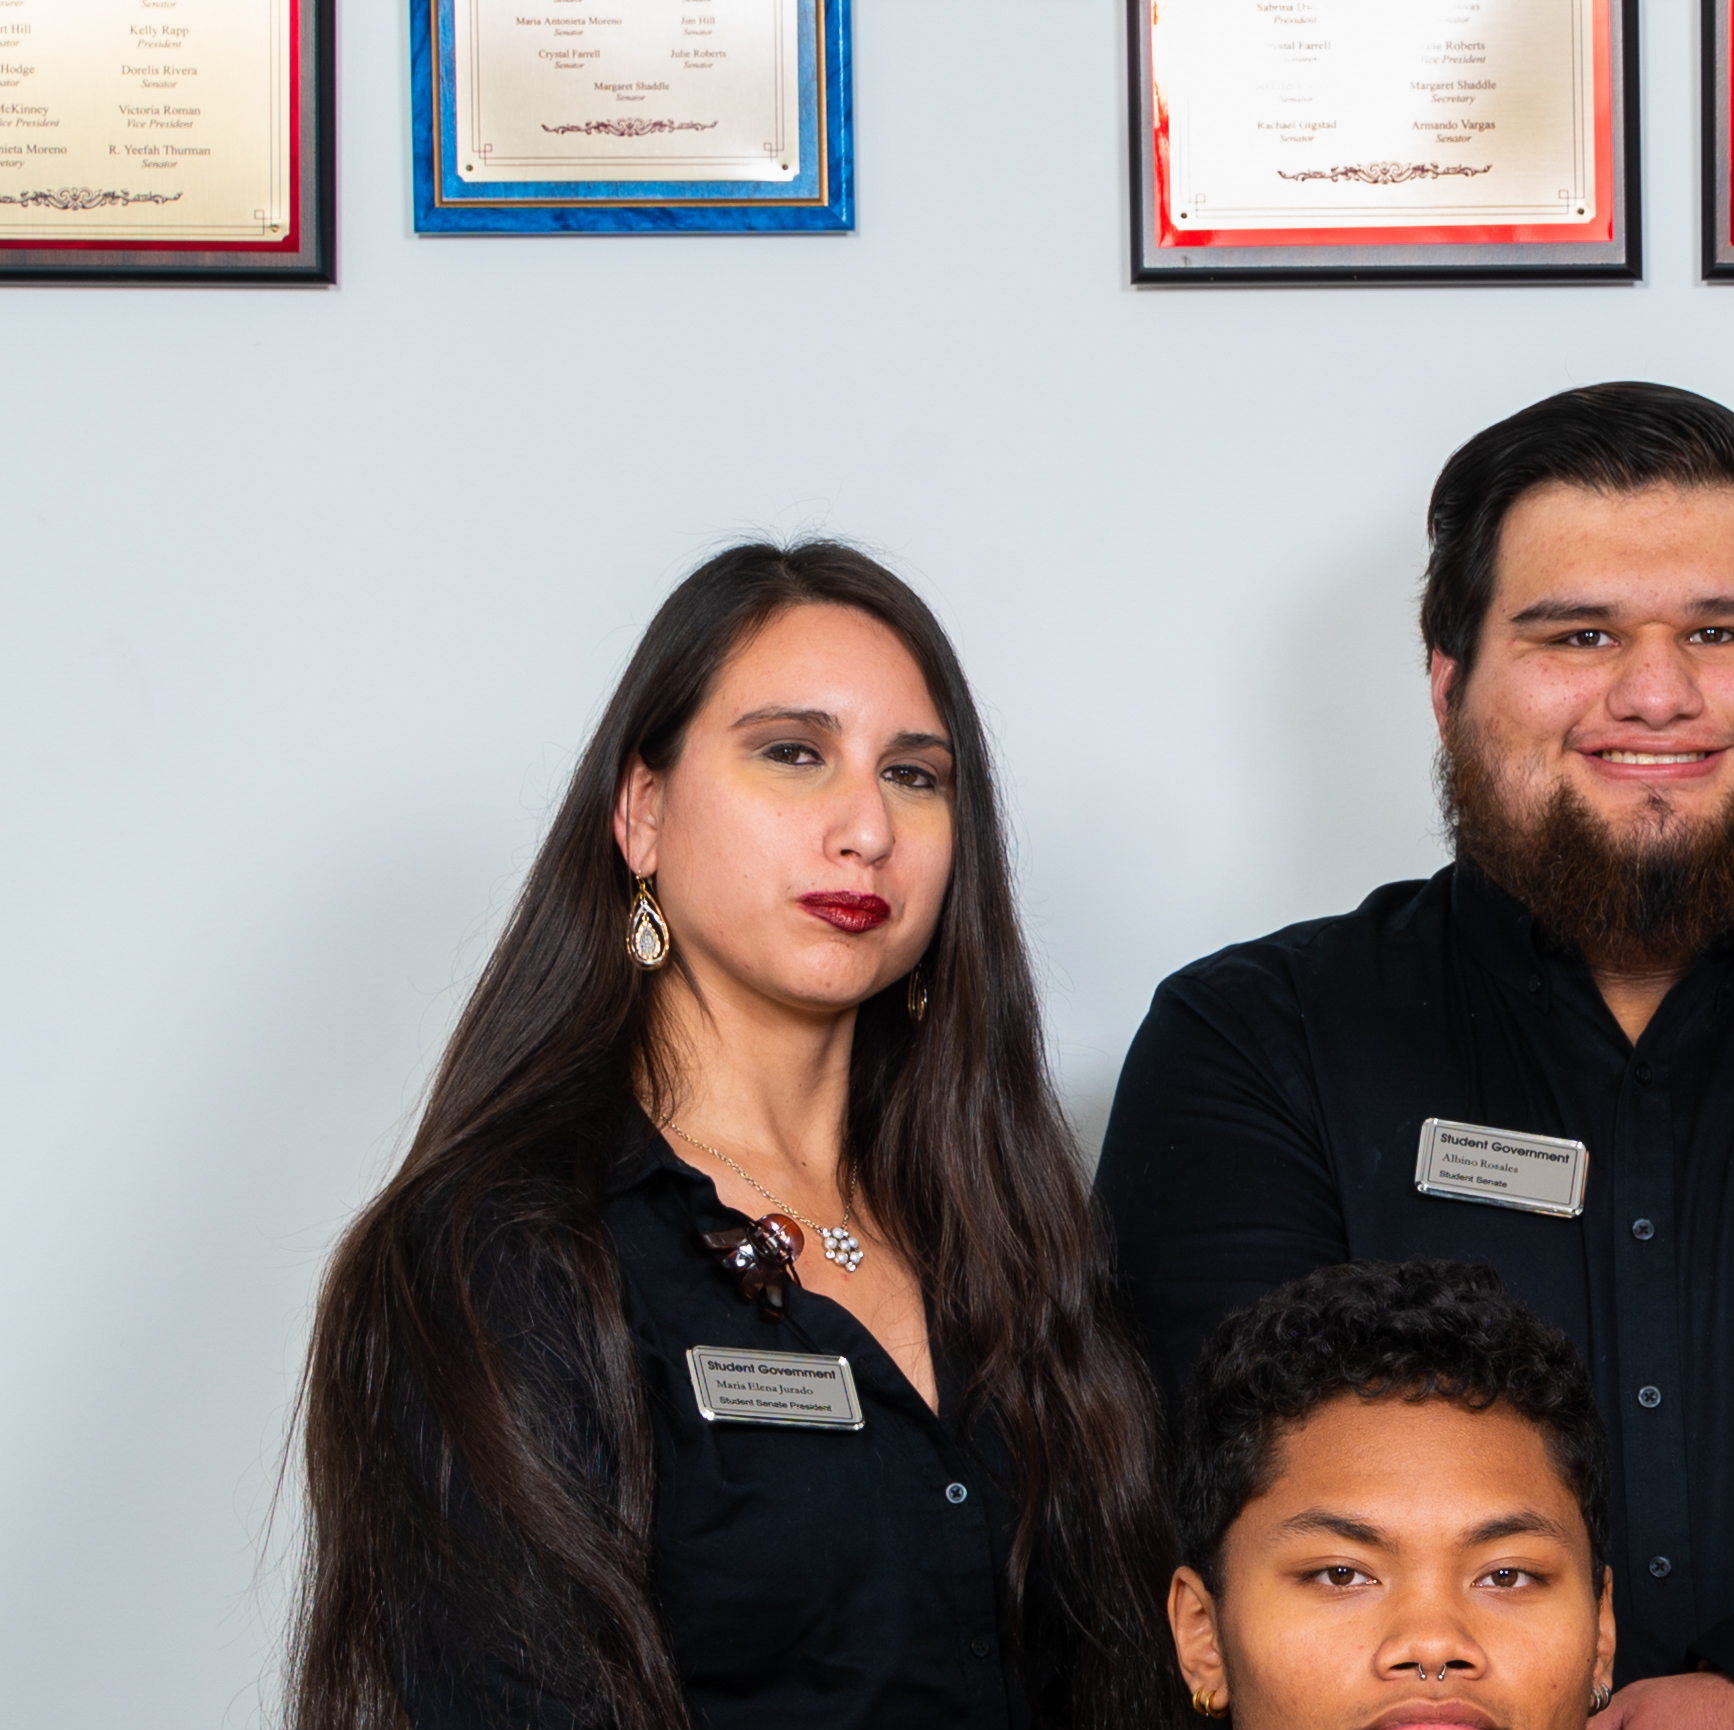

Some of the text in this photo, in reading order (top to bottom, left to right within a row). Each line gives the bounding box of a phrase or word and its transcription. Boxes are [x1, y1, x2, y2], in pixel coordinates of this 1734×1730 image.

[1441, 1133, 1569, 1164] Student Government
[1442, 1153, 1518, 1173] Albino Rosales
[1439, 1170, 1508, 1188] Student Senate
[708, 1361, 835, 1379] Student Government
[717, 1380, 813, 1395] Maria Elena Jurado
[720, 1396, 832, 1412] Student Senate President
